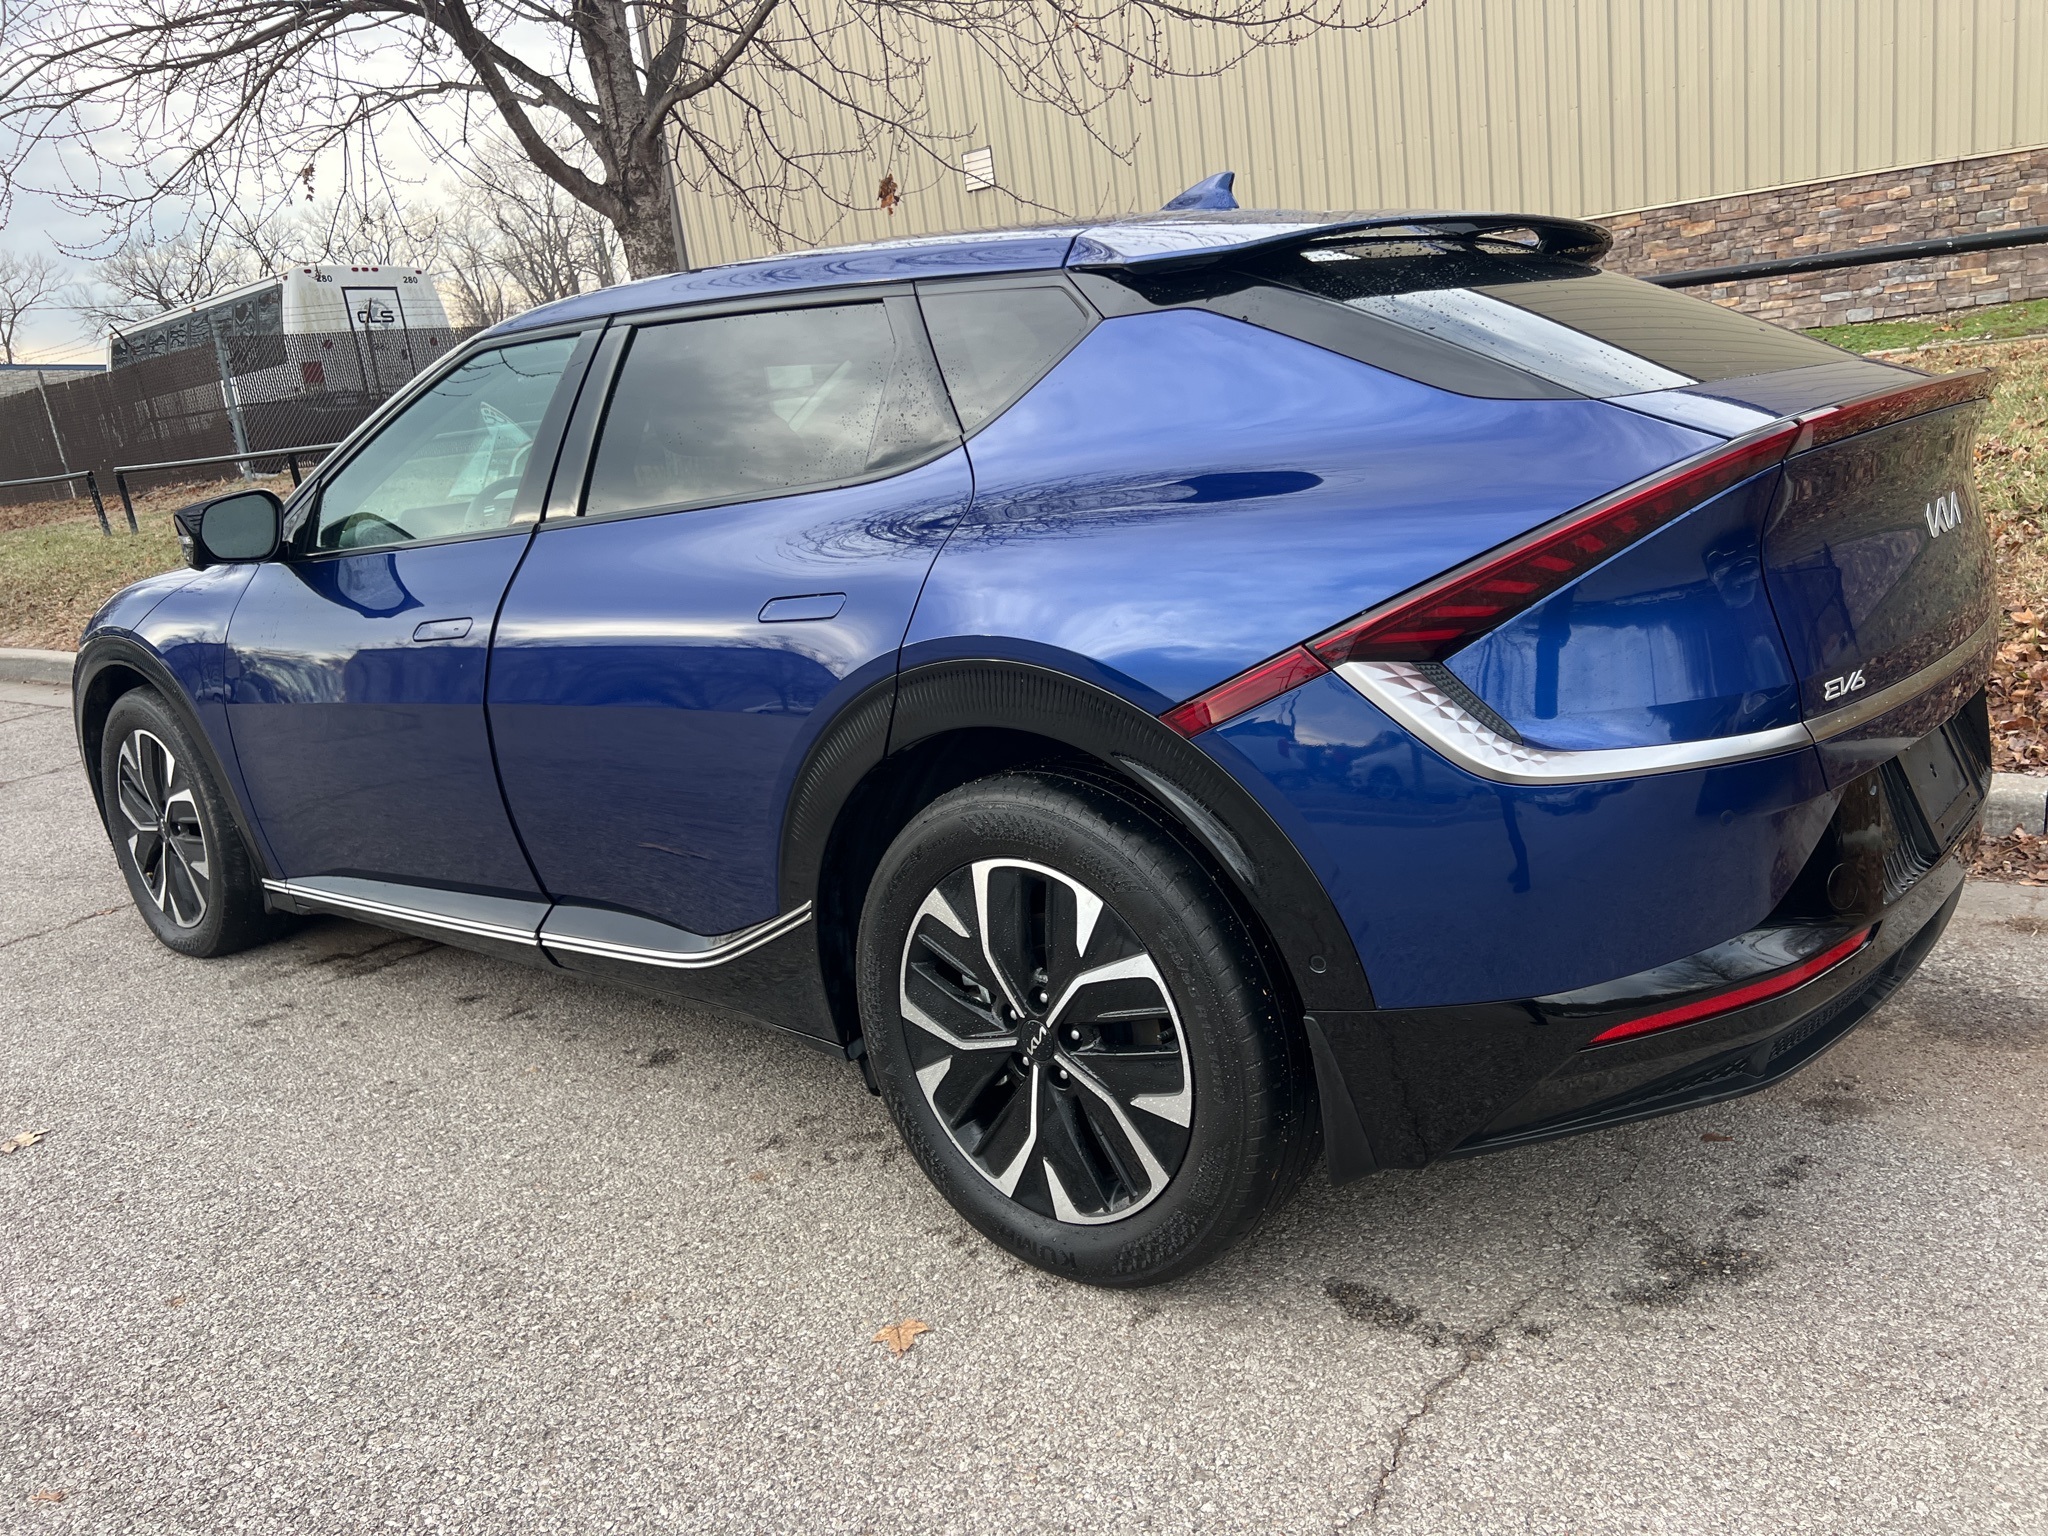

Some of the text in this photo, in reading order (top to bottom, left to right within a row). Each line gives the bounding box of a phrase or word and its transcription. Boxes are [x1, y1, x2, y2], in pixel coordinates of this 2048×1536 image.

[403, 276, 418, 284] 280
[1924, 490, 1962, 539] KIA
[1823, 669, 1866, 702] EV6
[1026, 1025, 1047, 1056] KIA
